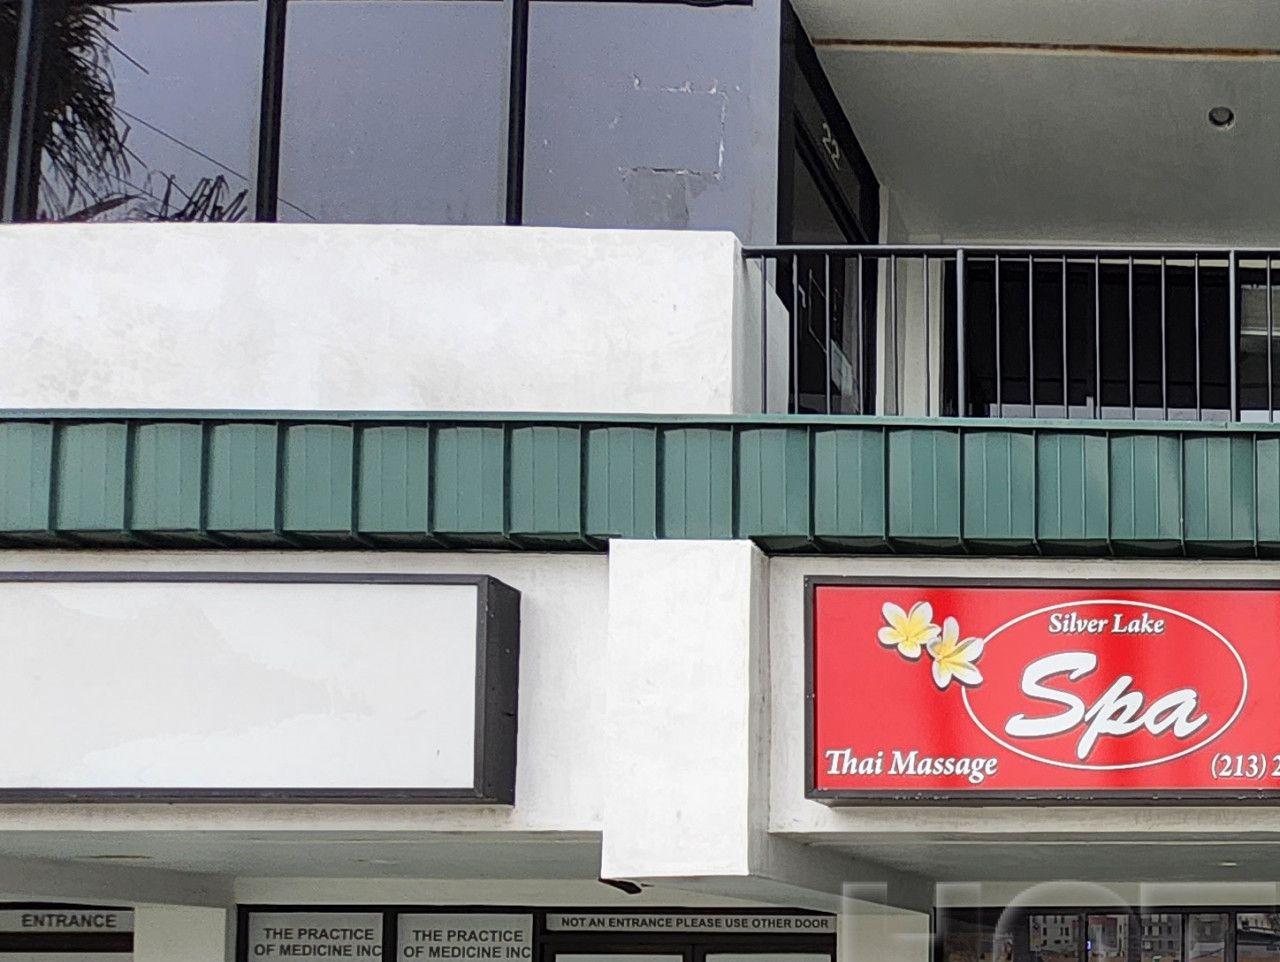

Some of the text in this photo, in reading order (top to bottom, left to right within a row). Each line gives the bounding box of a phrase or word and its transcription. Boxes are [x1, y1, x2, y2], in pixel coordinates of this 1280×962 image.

[1049, 612, 1165, 633] Silver Lake
[1004, 651, 1208, 760] Spa
[824, 747, 998, 784] Thai Massage
[1211, 752, 1267, 779] (213)
[21, 914, 117, 927] ENTRANCE
[561, 917, 829, 928] NOT AN ENTRANCE PLEASE USE OTHER DOOR
[264, 928, 374, 940] THE PRACTICE
[412, 930, 524, 941] THE PRACTICE
[254, 944, 382, 956] OF MEDICINE INC
[403, 946, 531, 958] OF MEDICINE INC
